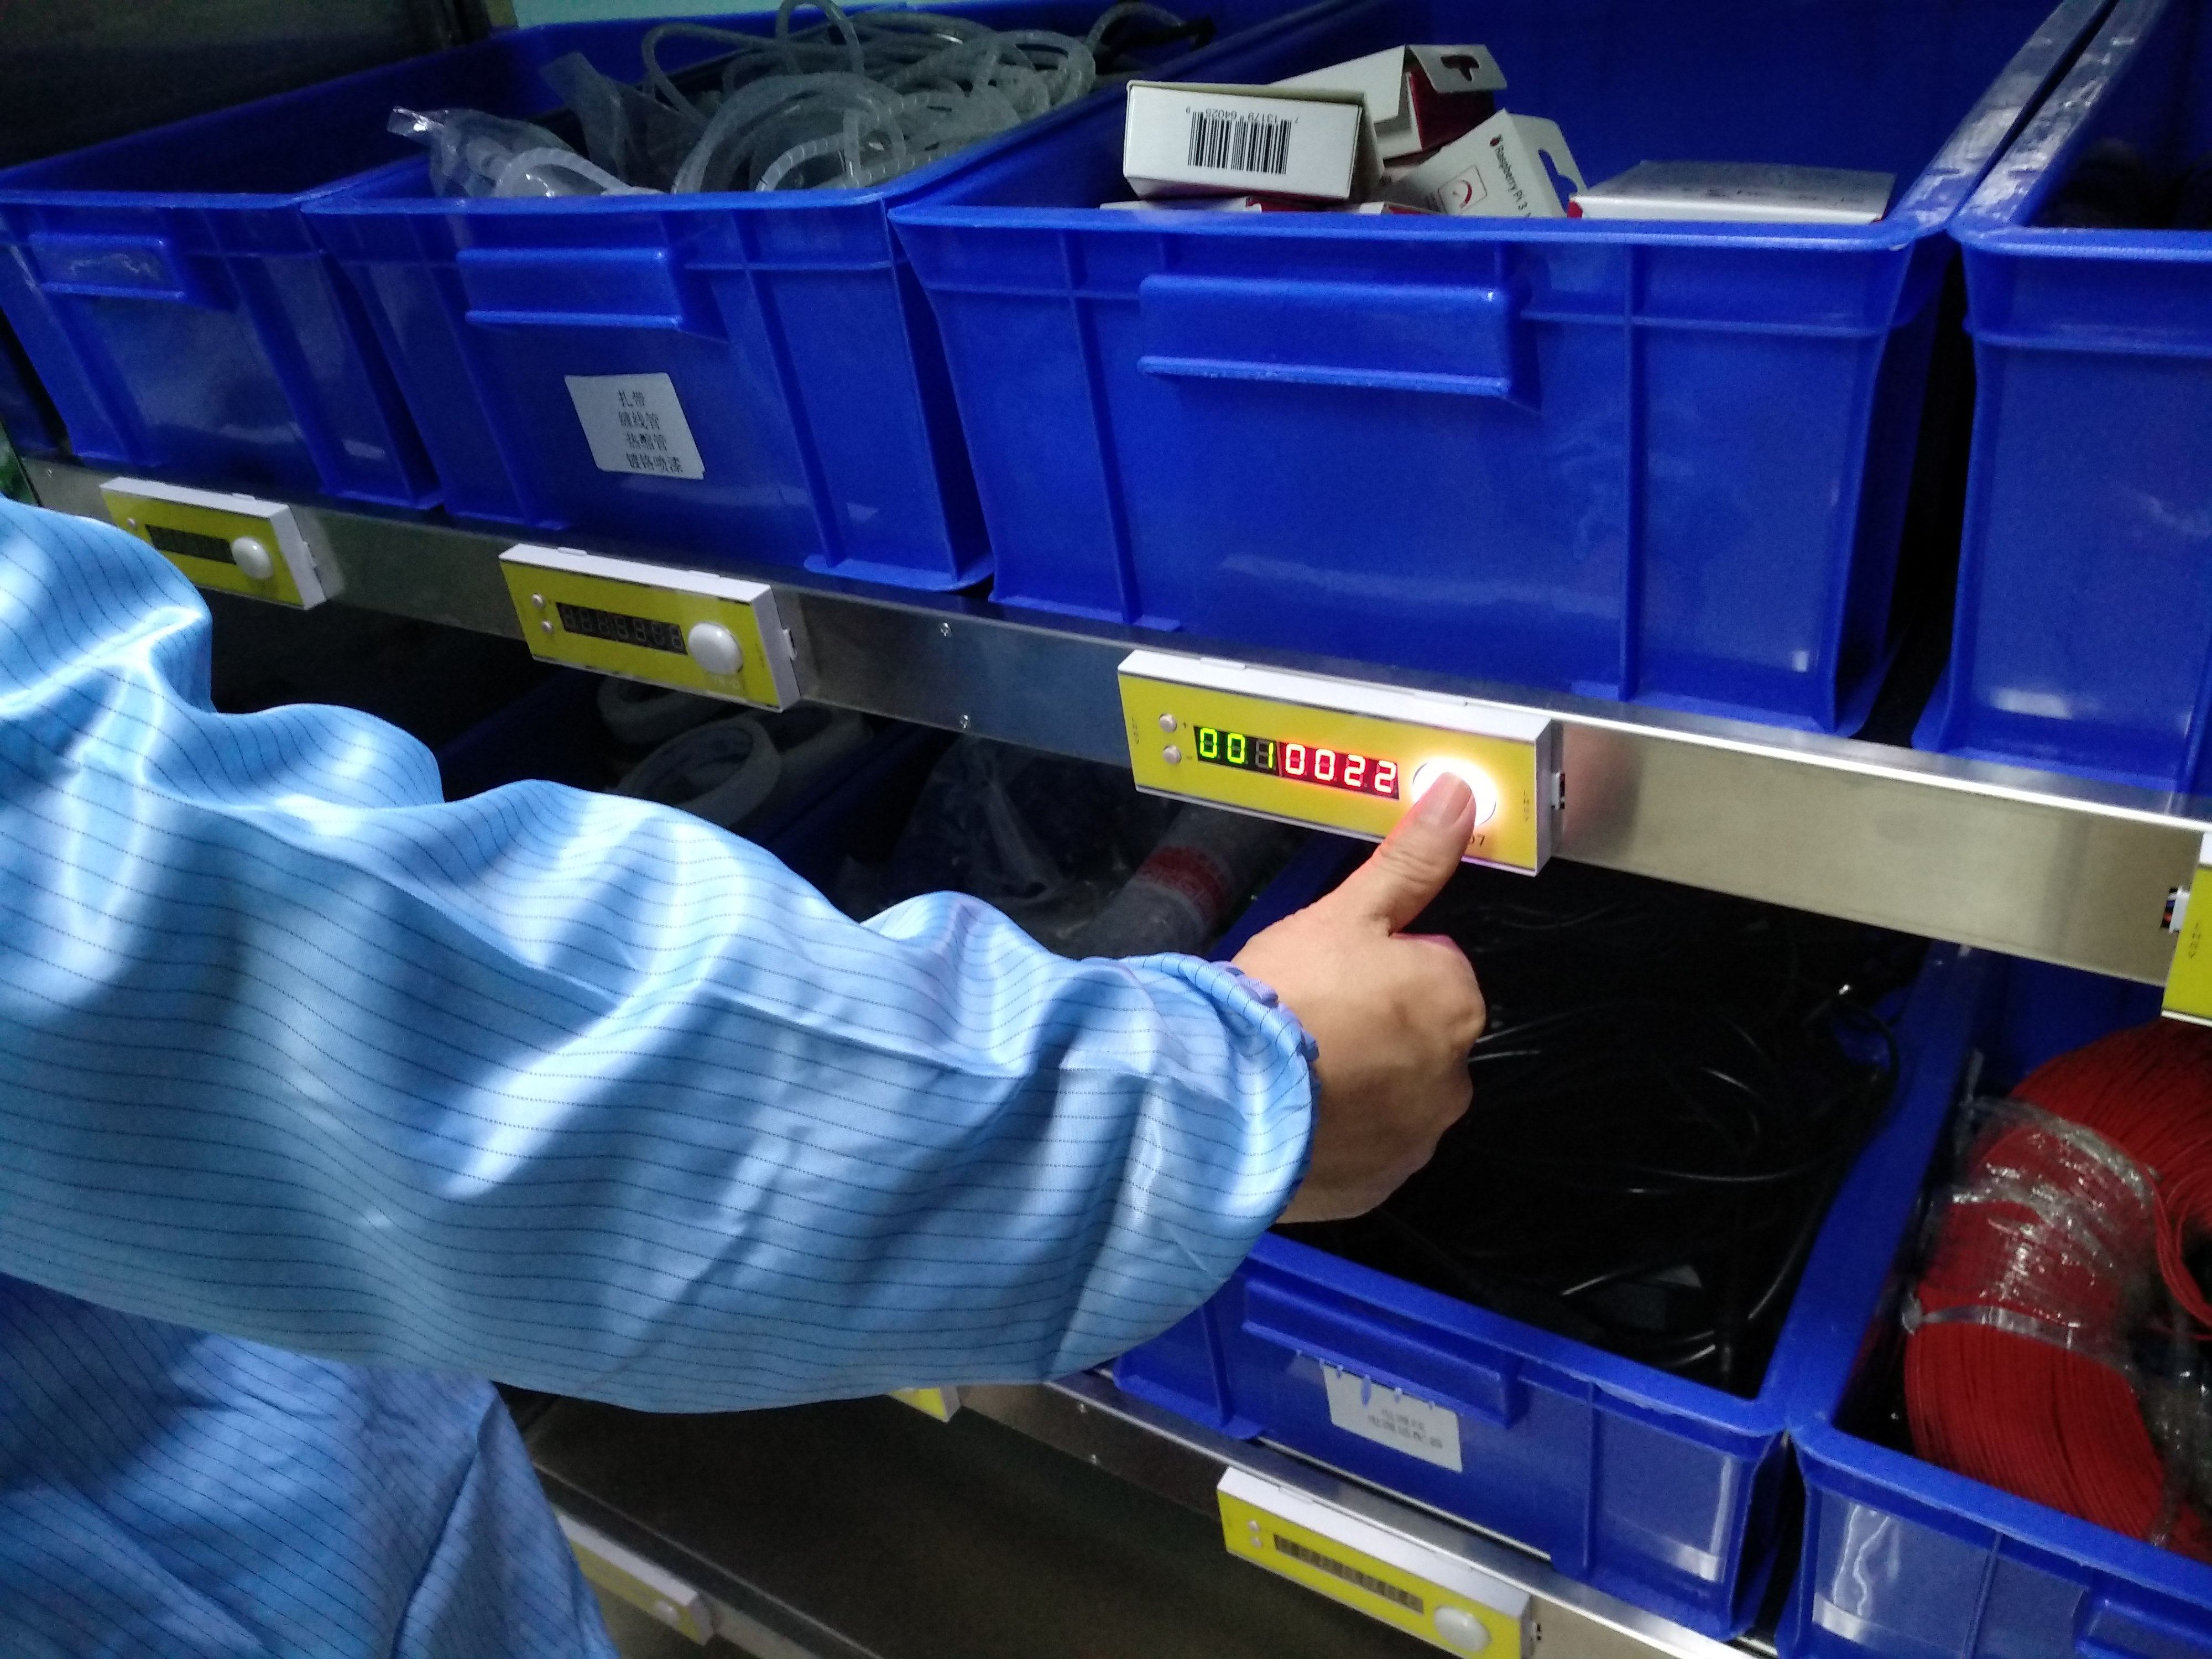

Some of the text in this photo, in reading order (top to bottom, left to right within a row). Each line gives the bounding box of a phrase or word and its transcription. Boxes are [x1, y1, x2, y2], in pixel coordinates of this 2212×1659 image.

[1495, 145, 1517, 192] Raspberry
[1513, 189, 1525, 202] Pi
[1518, 201, 1528, 210] 3
[1285, 742, 1397, 794] 0022
